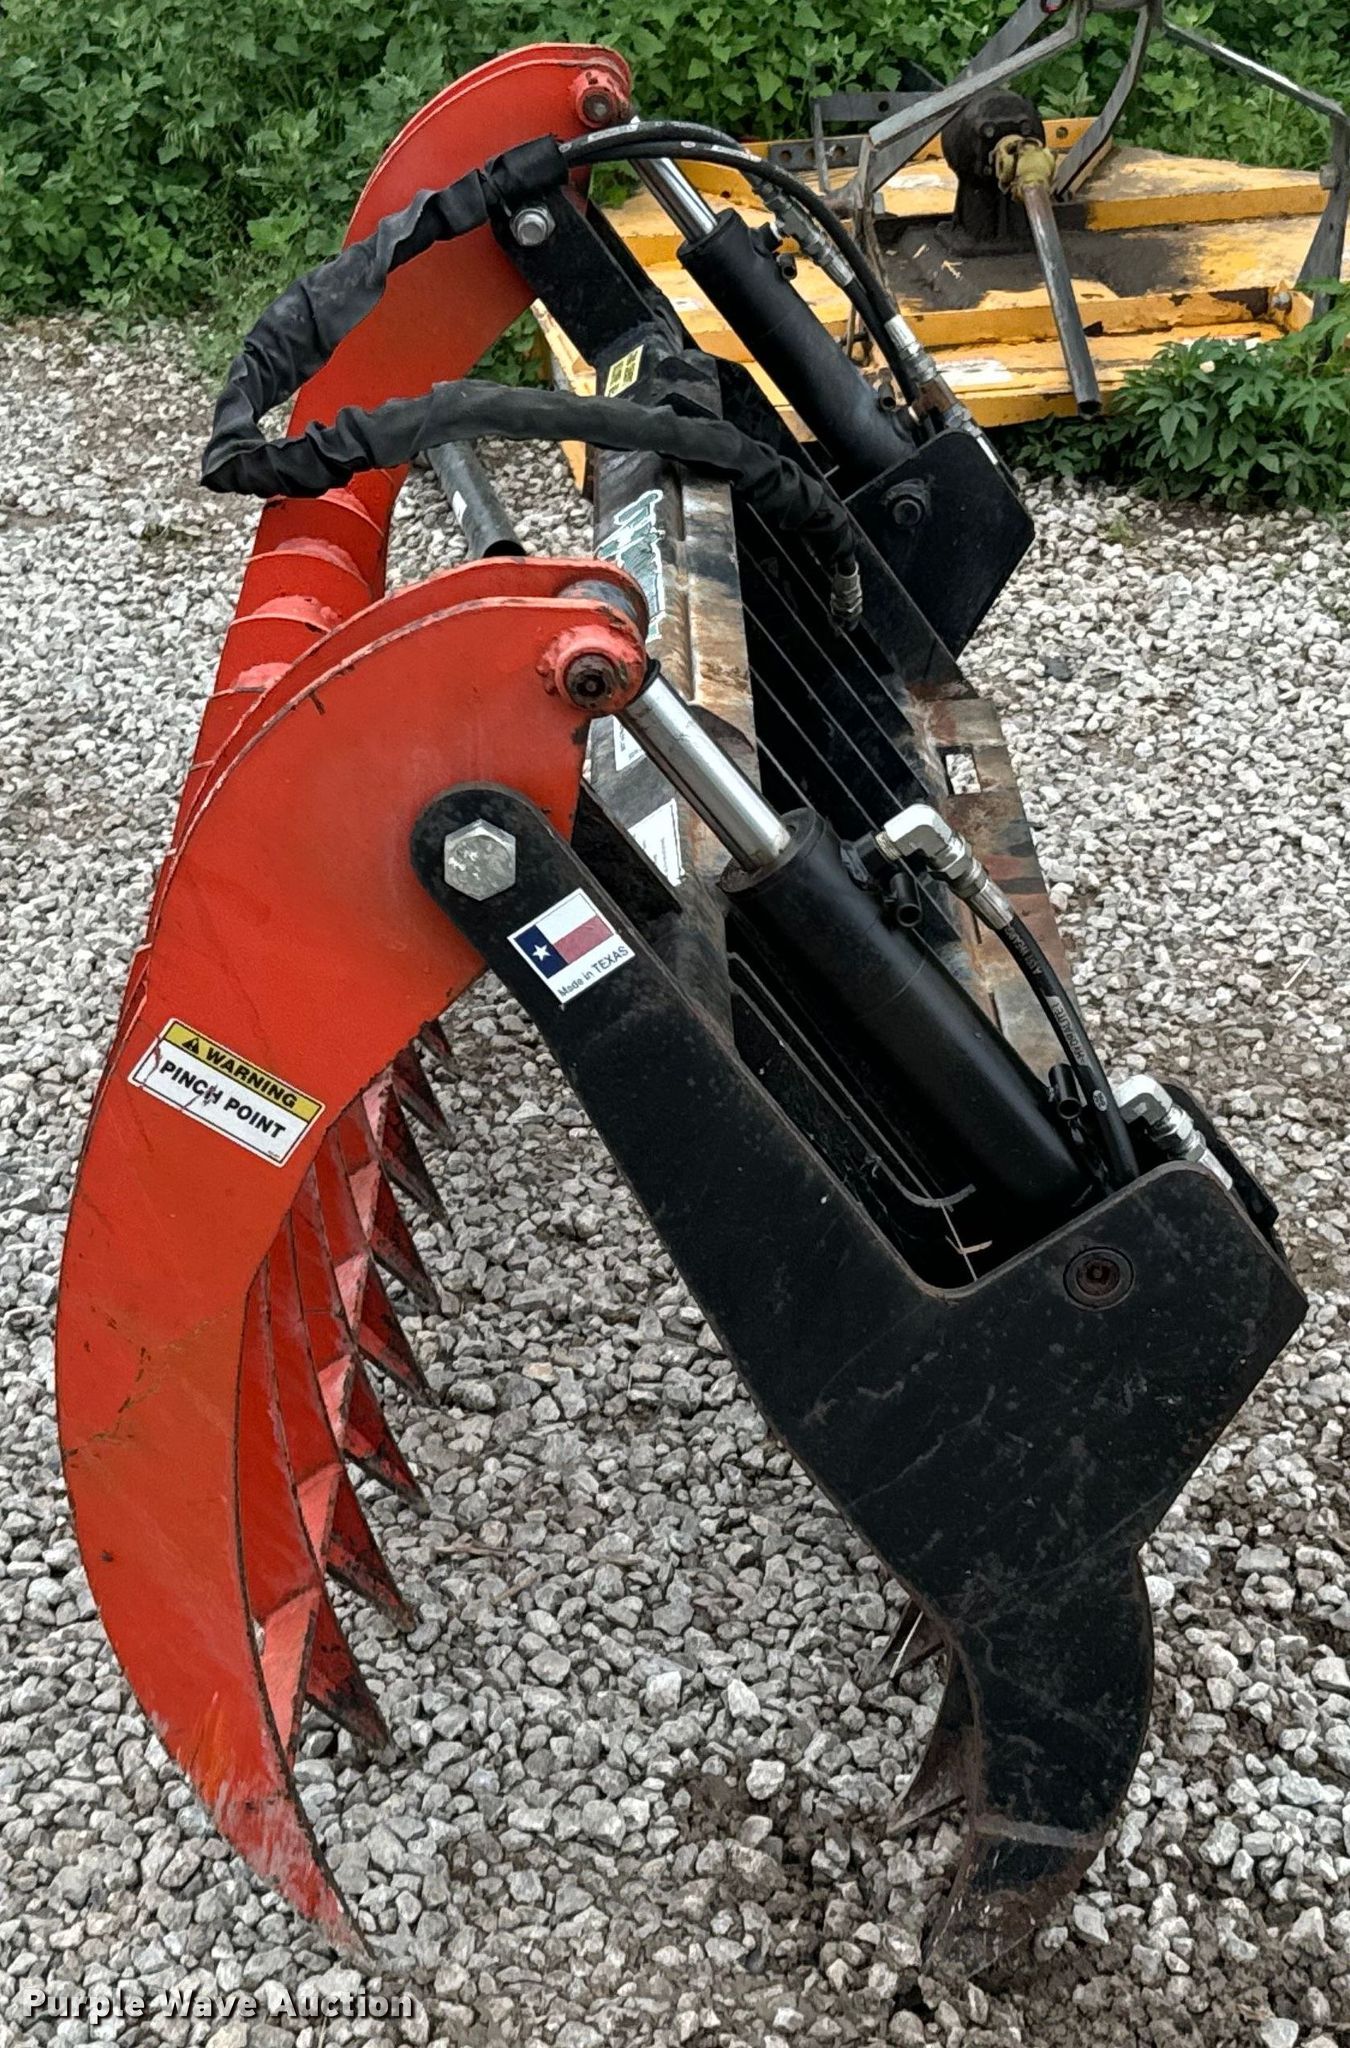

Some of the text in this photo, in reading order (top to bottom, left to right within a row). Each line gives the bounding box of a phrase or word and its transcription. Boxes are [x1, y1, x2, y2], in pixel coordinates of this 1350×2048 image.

[557, 945, 629, 996] Made in TEXAS
[160, 1060, 286, 1138] PINCH POINT
[206, 1047, 297, 1109] WARNING
